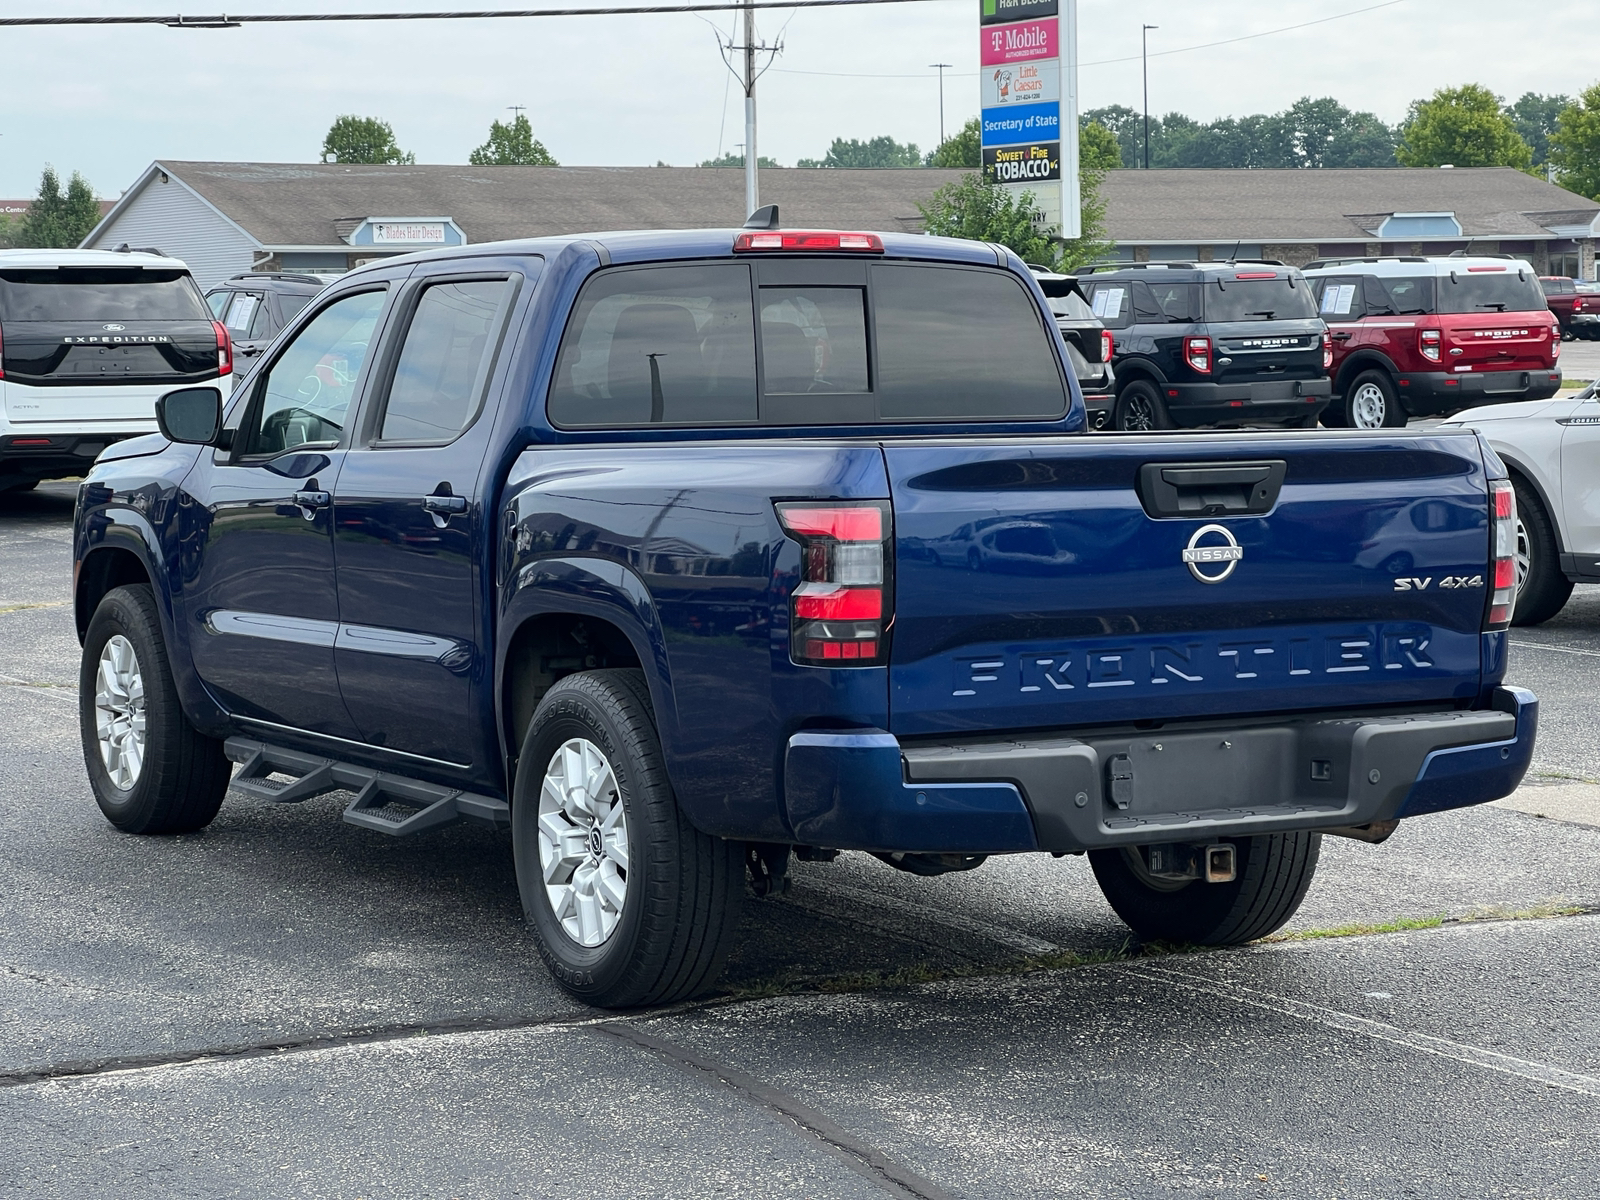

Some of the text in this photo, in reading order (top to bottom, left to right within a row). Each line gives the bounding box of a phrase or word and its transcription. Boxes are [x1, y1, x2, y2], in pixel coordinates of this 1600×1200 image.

[1005, 26, 1047, 50] Mobile
[1019, 66, 1038, 78] Little
[1014, 79, 1042, 92] Caesars
[984, 115, 1058, 131] Secretary of State
[996, 149, 1024, 162] SWEET
[995, 159, 1050, 180] TOBACCO
[386, 226, 442, 241] Blades Hair Design
[1243, 338, 1298, 346] BRONCO
[1185, 549, 1241, 560] NISSAN
[1394, 577, 1432, 591] SV
[952, 634, 1433, 696] FRONTIER
